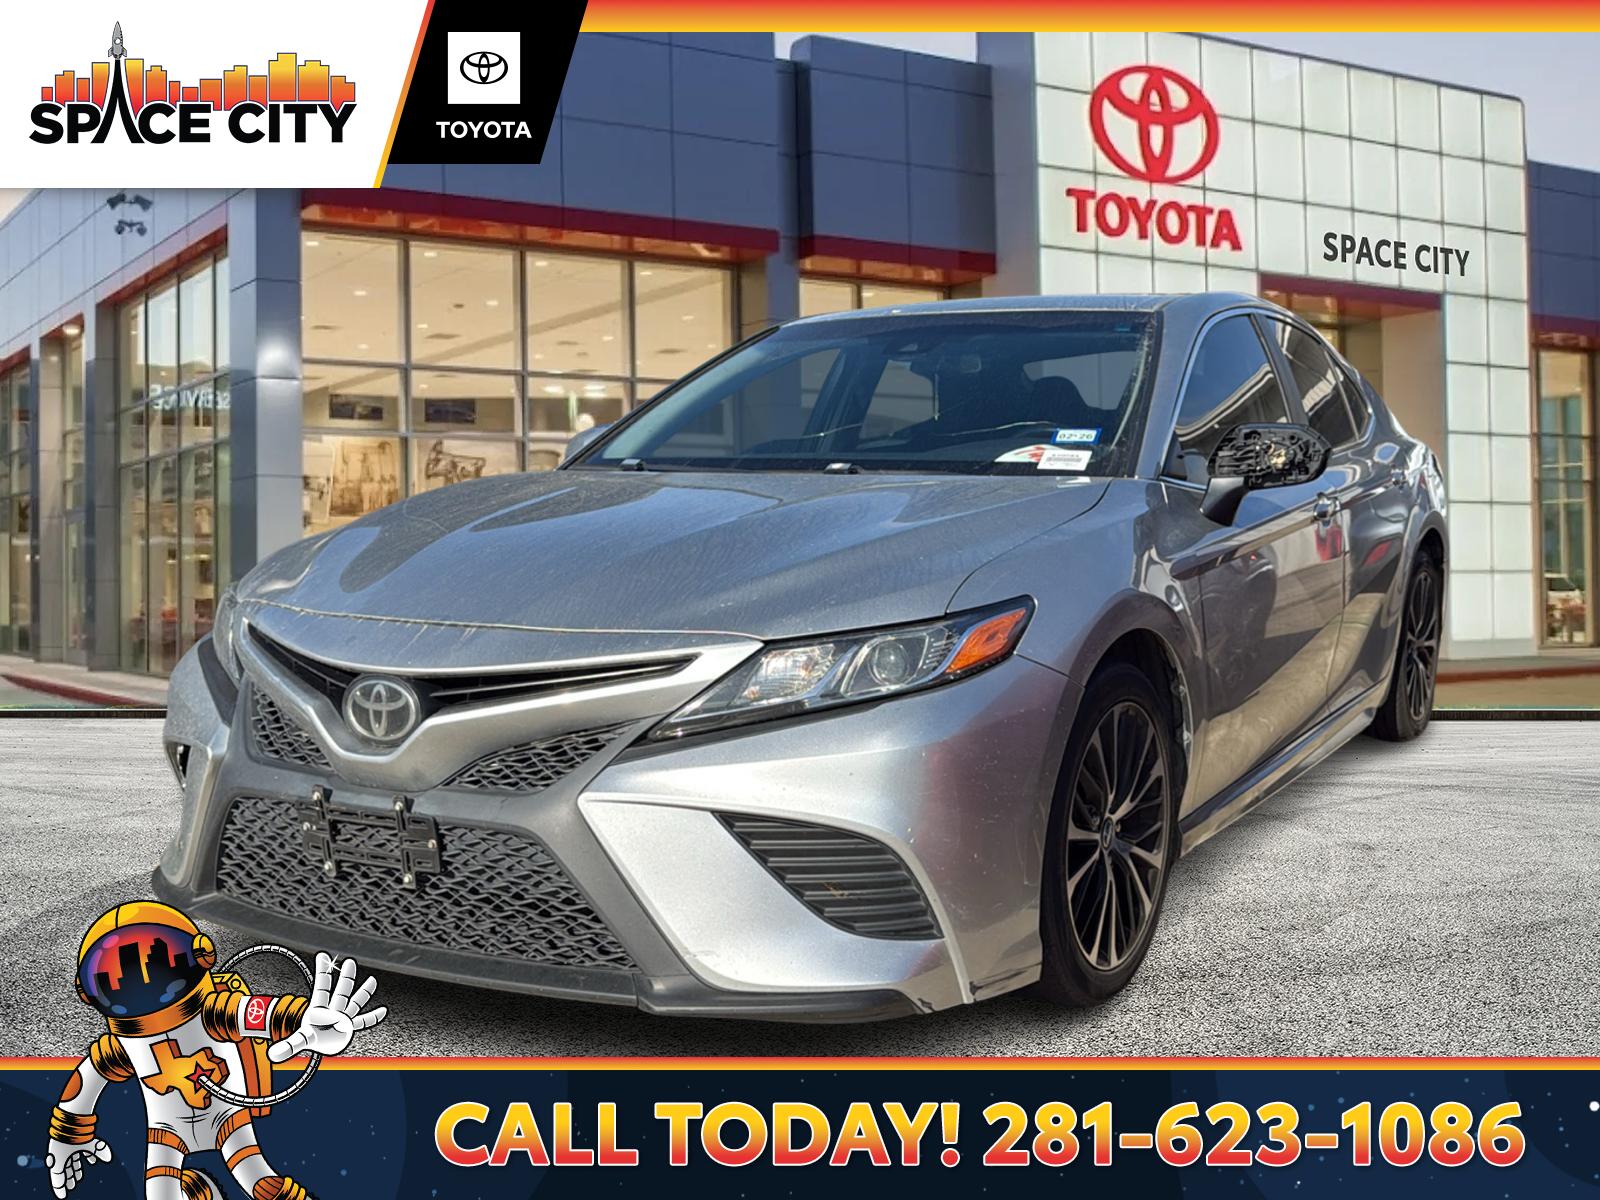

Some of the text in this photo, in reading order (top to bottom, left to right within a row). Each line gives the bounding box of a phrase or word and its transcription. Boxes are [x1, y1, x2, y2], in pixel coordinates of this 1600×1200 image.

[1066, 188, 1242, 251] TOYOTA
[1323, 232, 1470, 277] SPACE CITY
